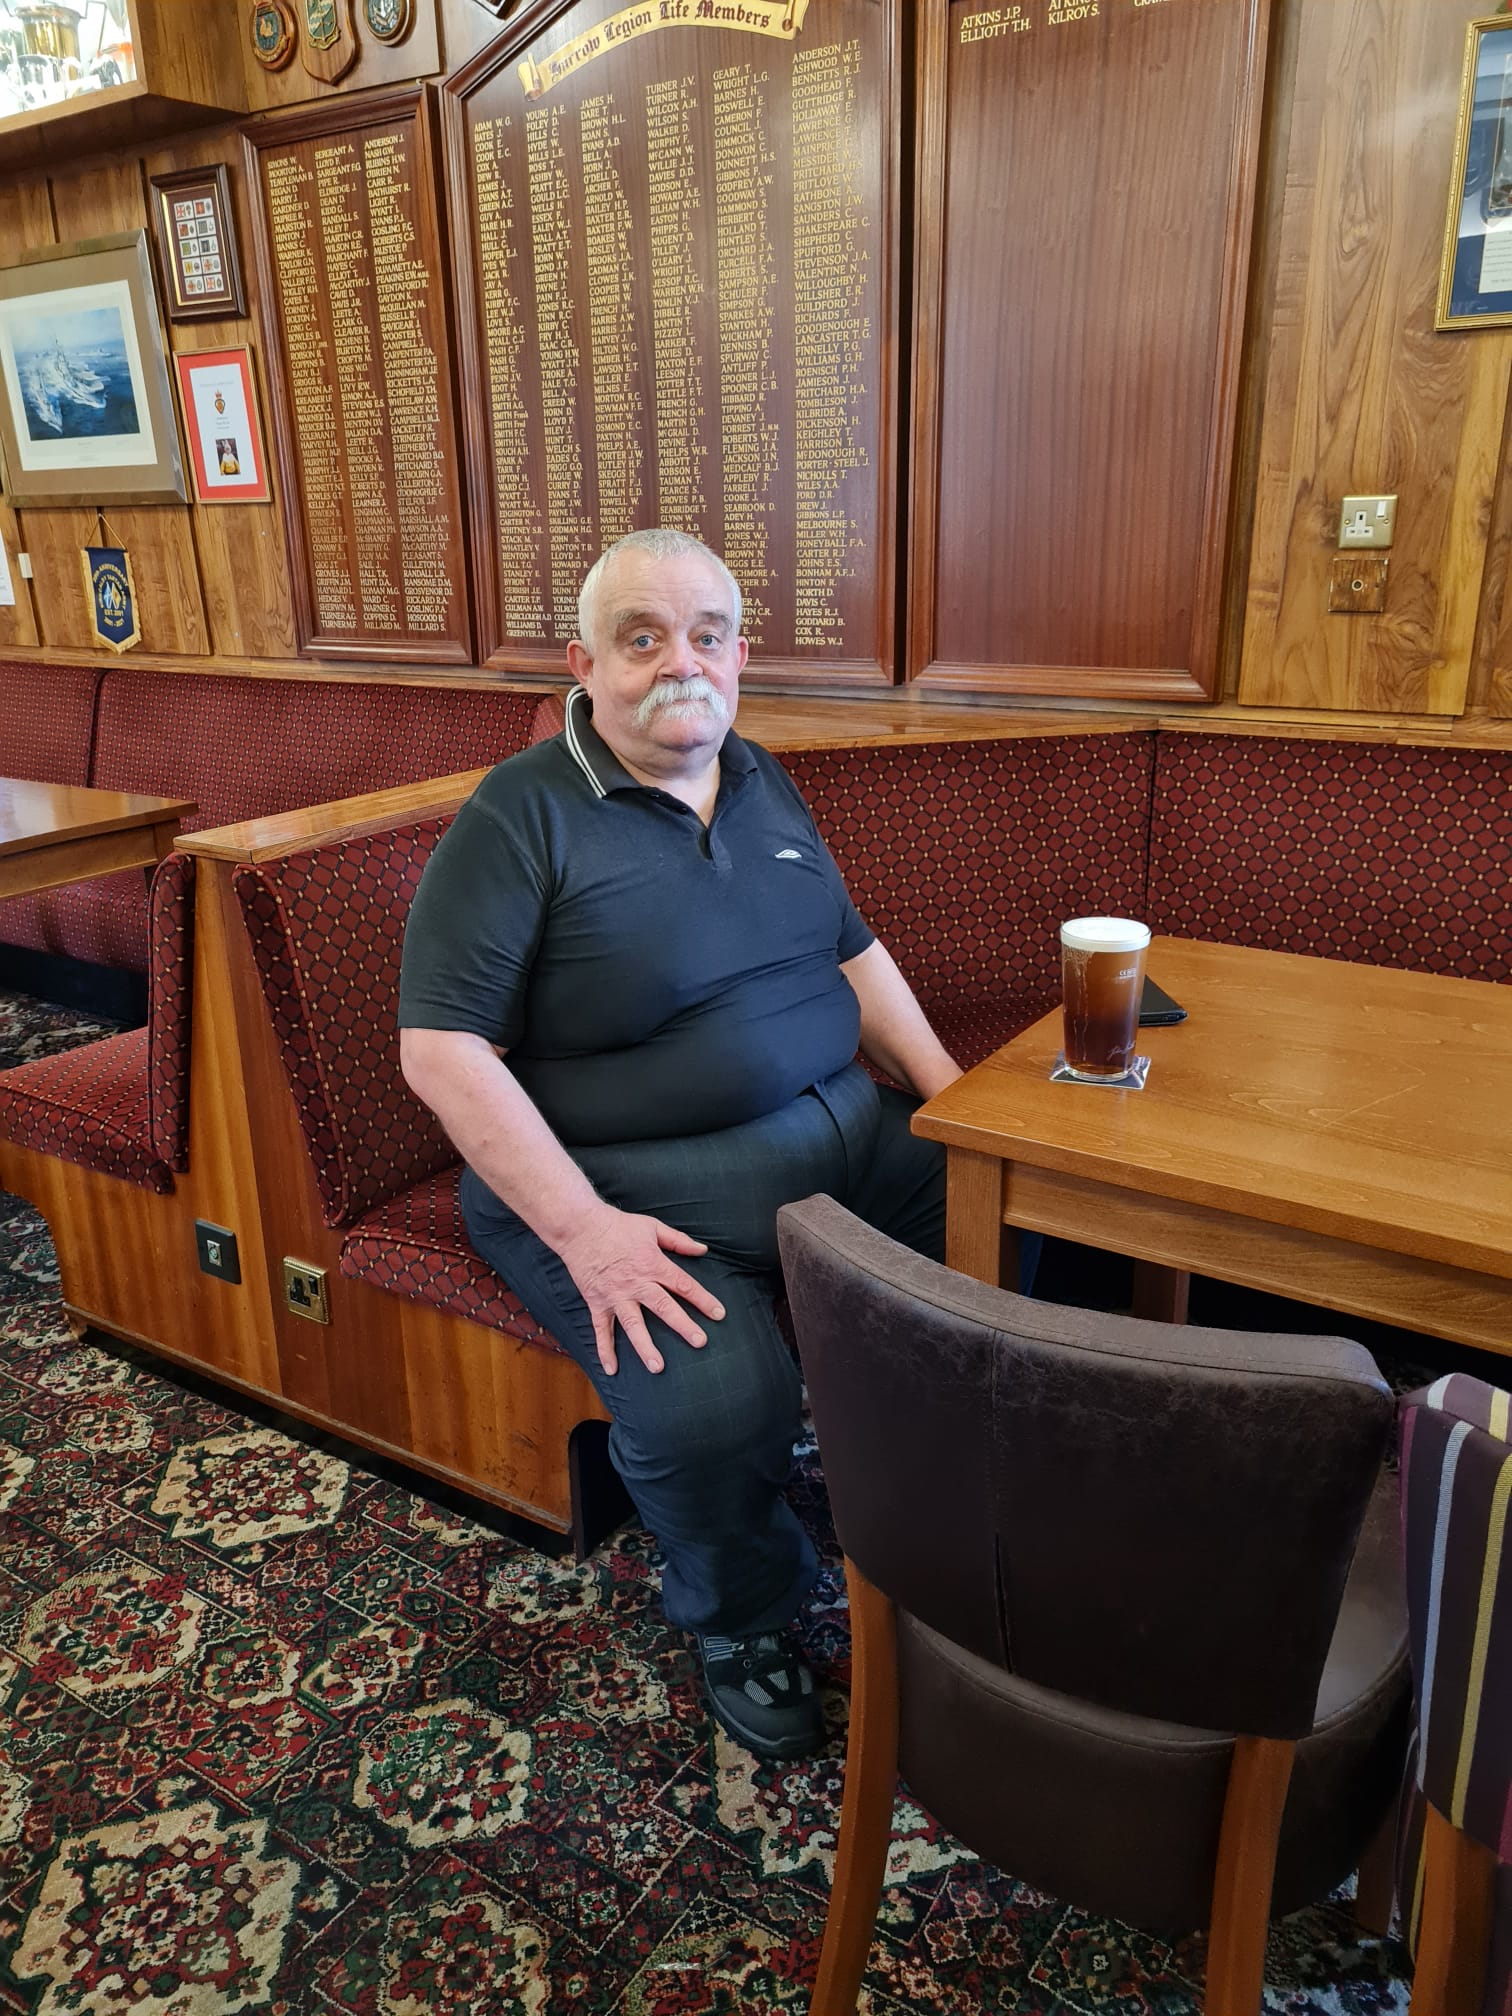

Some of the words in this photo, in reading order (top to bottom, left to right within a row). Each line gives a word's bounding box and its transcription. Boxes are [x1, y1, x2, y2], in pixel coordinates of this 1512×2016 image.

[604, 11, 652, 42] Legion
[659, 0, 689, 20] Life
[694, 0, 771, 28] Members
[960, 10, 1001, 29] ATKINS
[1048, 6, 1090, 25] KILROY
[960, 22, 1009, 43] ELLIOTT
[792, 44, 841, 63] ANDERSON
[713, 66, 740, 81] GEARY
[744, 64, 752, 73] T.
[792, 57, 837, 75] ASHWOOD
[713, 75, 749, 91] WRIGHT
[792, 68, 840, 86] BENNETTS
[646, 80, 678, 95] TURNER
[714, 88, 747, 103] BARNES
[750, 86, 759, 95] H.
[792, 80, 841, 98] GOODHEAD
[580, 96, 604, 110] JAMES
[607, 93, 615, 104] H.
[646, 91, 678, 106] TURNER
[681, 89, 688, 99] R.
[792, 91, 844, 111] GUTTRIDGE
[848, 90, 856, 99] R.
[581, 108, 600, 120] DARE
[602, 106, 609, 115] T.
[646, 102, 679, 117] WILCOX
[714, 98, 754, 115] BOSWELL
[792, 104, 840, 122] HOLDAWAY
[526, 108, 549, 121] YOUNG
[647, 113, 679, 127] WILSON
[527, 129, 548, 142] HILLS
[715, 122, 751, 137] COUNCIL
[364, 135, 398, 150] ANDERSON
[475, 141, 494, 152] COOK
[715, 133, 755, 149] DIMMOCK
[715, 144, 756, 160] DONAVON
[715, 155, 757, 171] DUNNETT
[793, 187, 841, 203] RATHBONE
[717, 200, 758, 215] HAMMOND
[762, 199, 768, 208] S.
[793, 198, 841, 214] SANGSTON
[650, 213, 678, 225] EASTON
[682, 211, 690, 220] H.
[717, 212, 754, 226] HERBERT
[758, 210, 766, 220] G.
[793, 211, 840, 225] SAUNDERS
[651, 223, 678, 236] PHIPPS
[717, 222, 757, 237] HOLLAND
[760, 221, 767, 230] T.
[794, 219, 858, 237] SHAKESPEARE
[862, 217, 871, 226] C.
[652, 233, 684, 247] NUGENT
[687, 232, 694, 241] D.
[794, 233, 840, 248] SHEPHERD
[794, 244, 841, 259] SPUFFORD
[846, 242, 855, 251] G.
[794, 254, 848, 270] STEVENSON
[794, 265, 846, 280] VALENTINE
[850, 264, 859, 273] N.
[794, 275, 855, 291] WILLOUGHBY
[860, 274, 868, 283] H.
[795, 298, 848, 313] GUILDFORD
[852, 297, 860, 307] J.
[720, 320, 757, 332] STANTON
[761, 319, 770, 327] H.
[795, 319, 860, 335] GOODENOUGH
[720, 330, 762, 342] WICKHAM
[795, 331, 849, 345] LANCASTER
[720, 340, 757, 352] DENNISS
[720, 351, 760, 363] SPURWAY
[763, 350, 772, 359] C.
[795, 354, 841, 366] WILLIAMS
[721, 361, 757, 374] ANTLIFF
[795, 376, 839, 388] JAMIESON
[795, 386, 846, 398] PRITCHARD
[796, 396, 847, 408] TOMBLESON
[851, 396, 858, 404] J.
[796, 408, 836, 419] KILBRIDE
[838, 406, 847, 416] A.
[796, 417, 848, 429] DICKENSON
[852, 416, 861, 425] H.
[796, 428, 842, 440] KEIGHLEY
[845, 427, 853, 436] T.
[796, 438, 842, 450] HARRISON
[847, 437, 855, 447] T.
[859, 447, 868, 456] R.
[796, 470, 837, 481] NICHOLLS
[840, 470, 848, 480] T.
[548, 482, 571, 490] CURRY
[573, 481, 580, 489] D.
[660, 487, 689, 495] PEARCE
[692, 486, 699, 494] S.
[724, 503, 765, 512] SEABROOK
[796, 520, 848, 529] MELBOURNE
[851, 519, 858, 528] S.
[796, 579, 826, 587] HINTON
[796, 617, 835, 626] GODDARD
